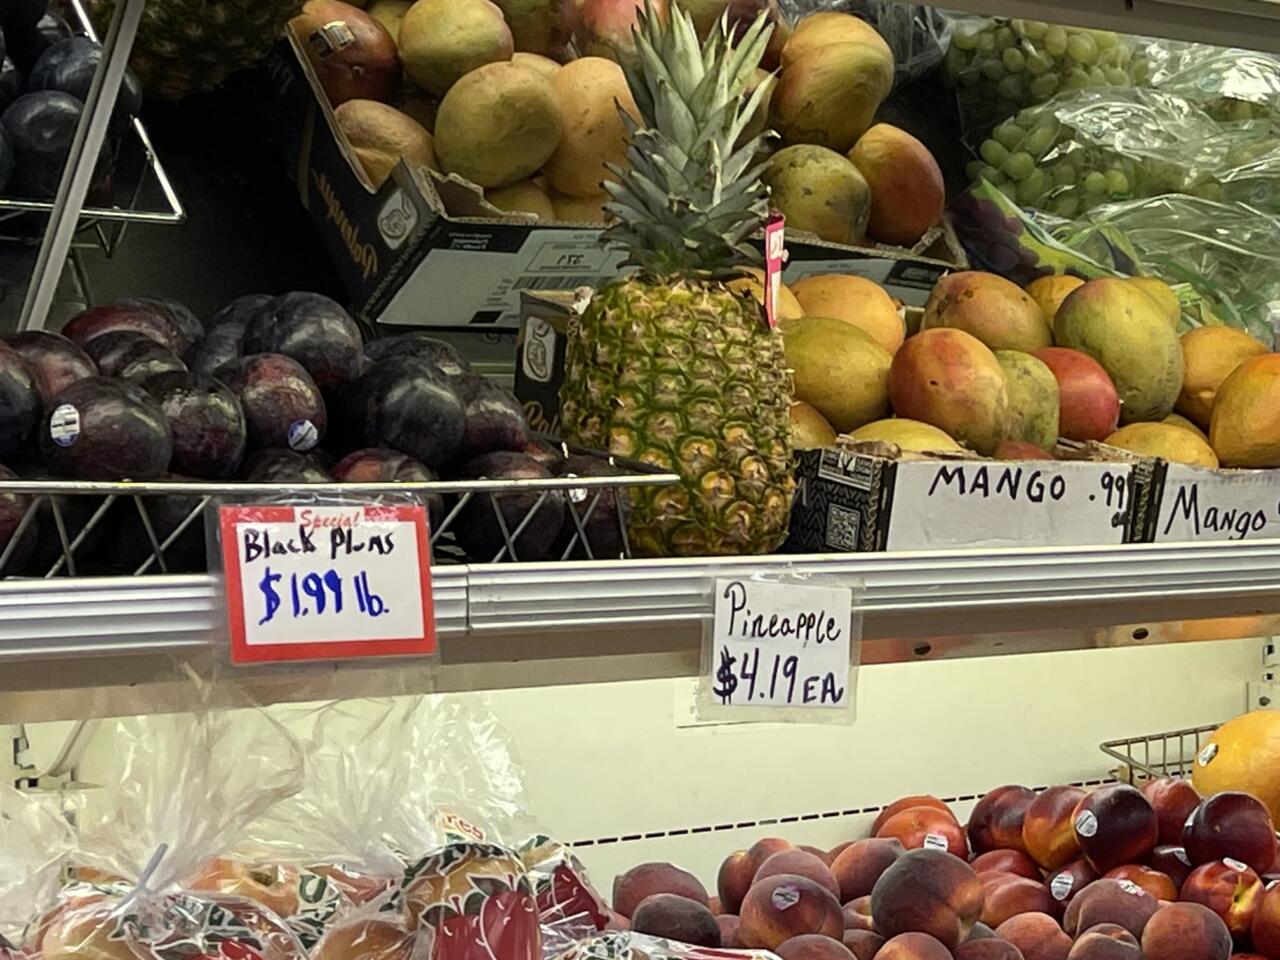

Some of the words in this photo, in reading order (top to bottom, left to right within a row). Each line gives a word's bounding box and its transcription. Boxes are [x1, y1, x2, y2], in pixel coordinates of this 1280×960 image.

[928, 465, 1066, 503] MANGO
[1165, 484, 1267, 540] Mango
[244, 524, 317, 563] Black
[300, 509, 359, 529] Special
[258, 566, 342, 626] $1.99
[724, 581, 841, 648] Pineapple
[713, 645, 798, 705] $4.19
